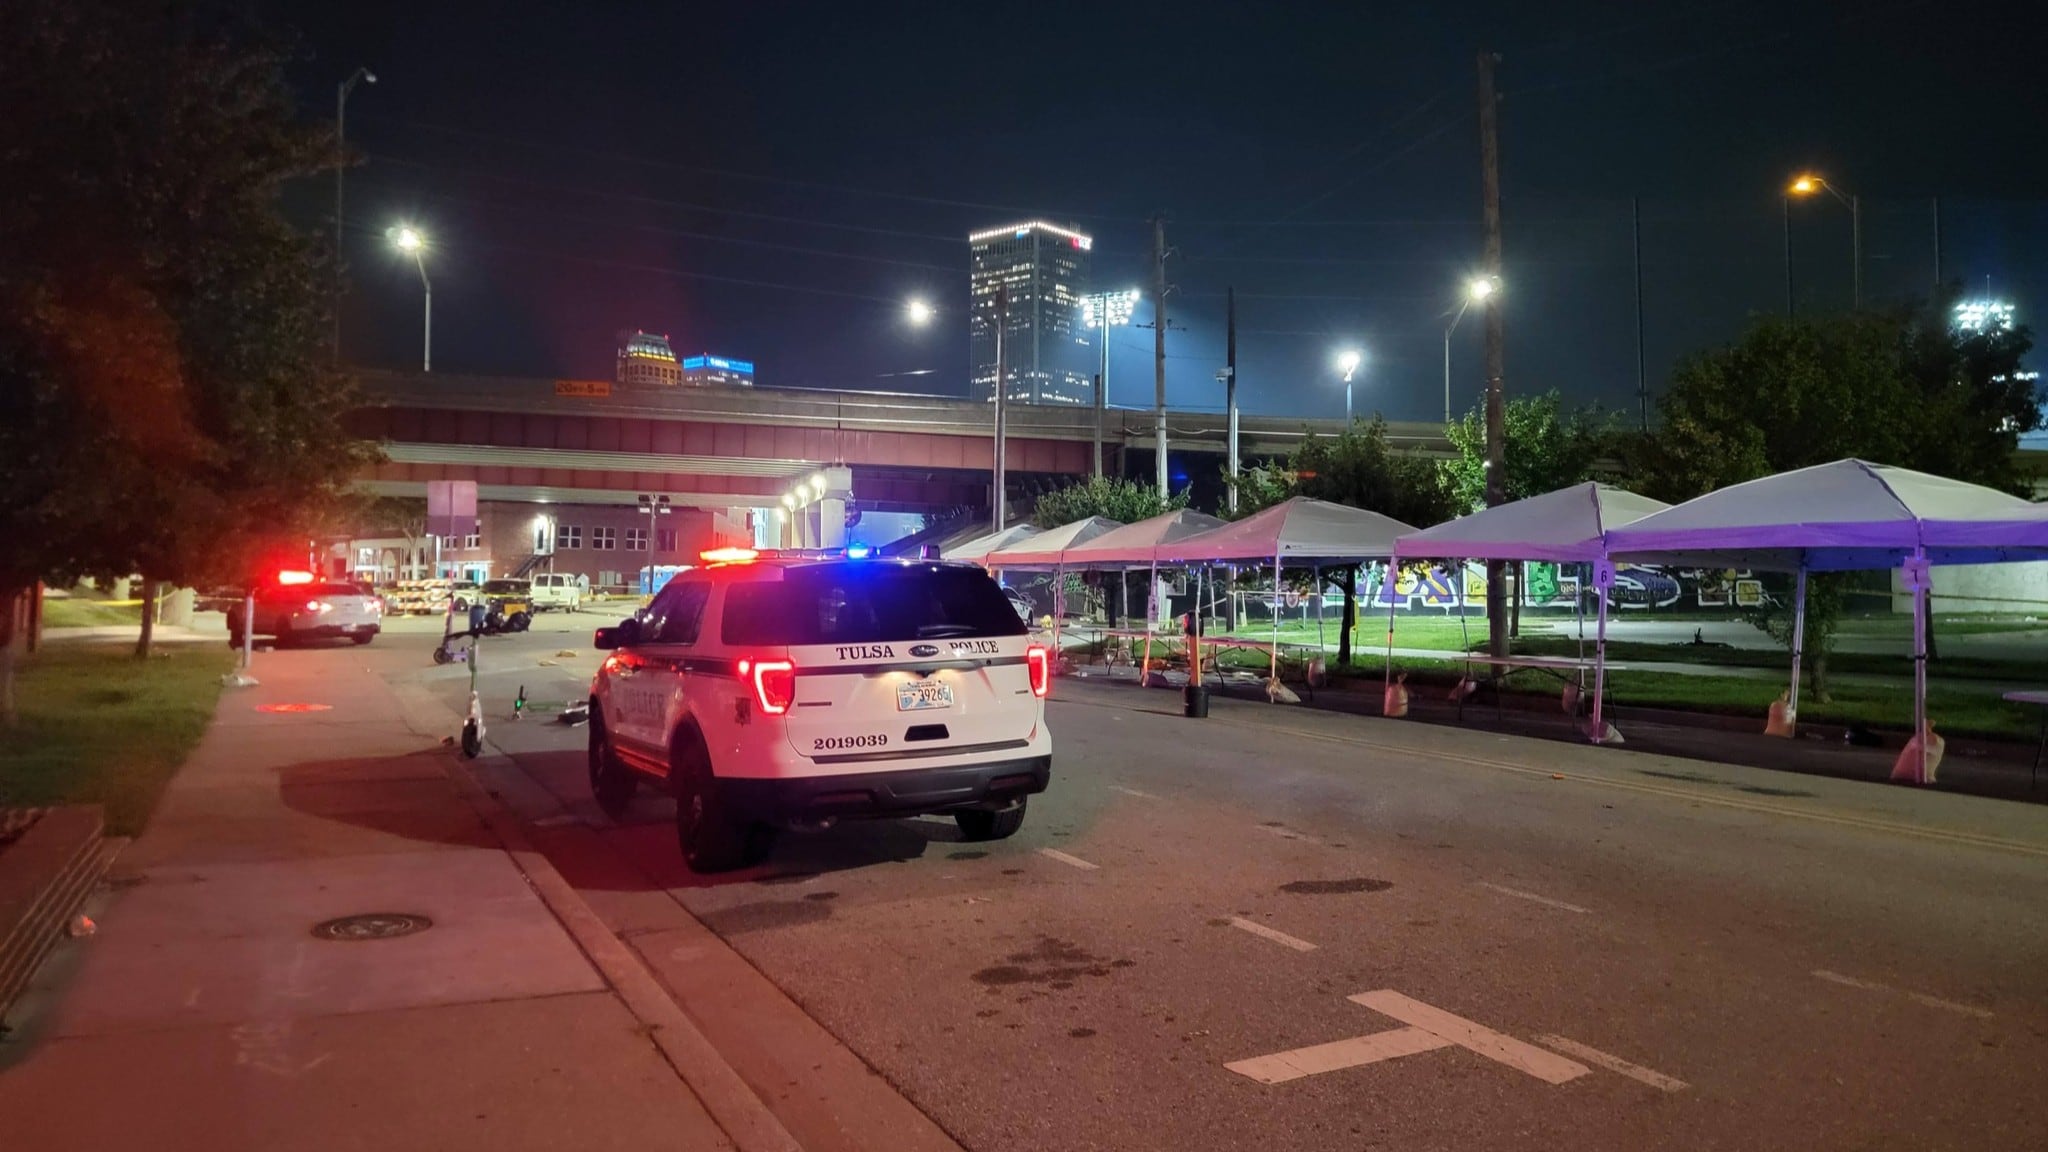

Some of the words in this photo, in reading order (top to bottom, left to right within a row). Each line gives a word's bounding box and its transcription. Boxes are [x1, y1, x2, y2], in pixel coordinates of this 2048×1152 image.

[1600, 569, 1608, 583] 6
[836, 644, 895, 660] TULSA
[949, 640, 999, 656] POLICE
[814, 734, 888, 750] 2019039
